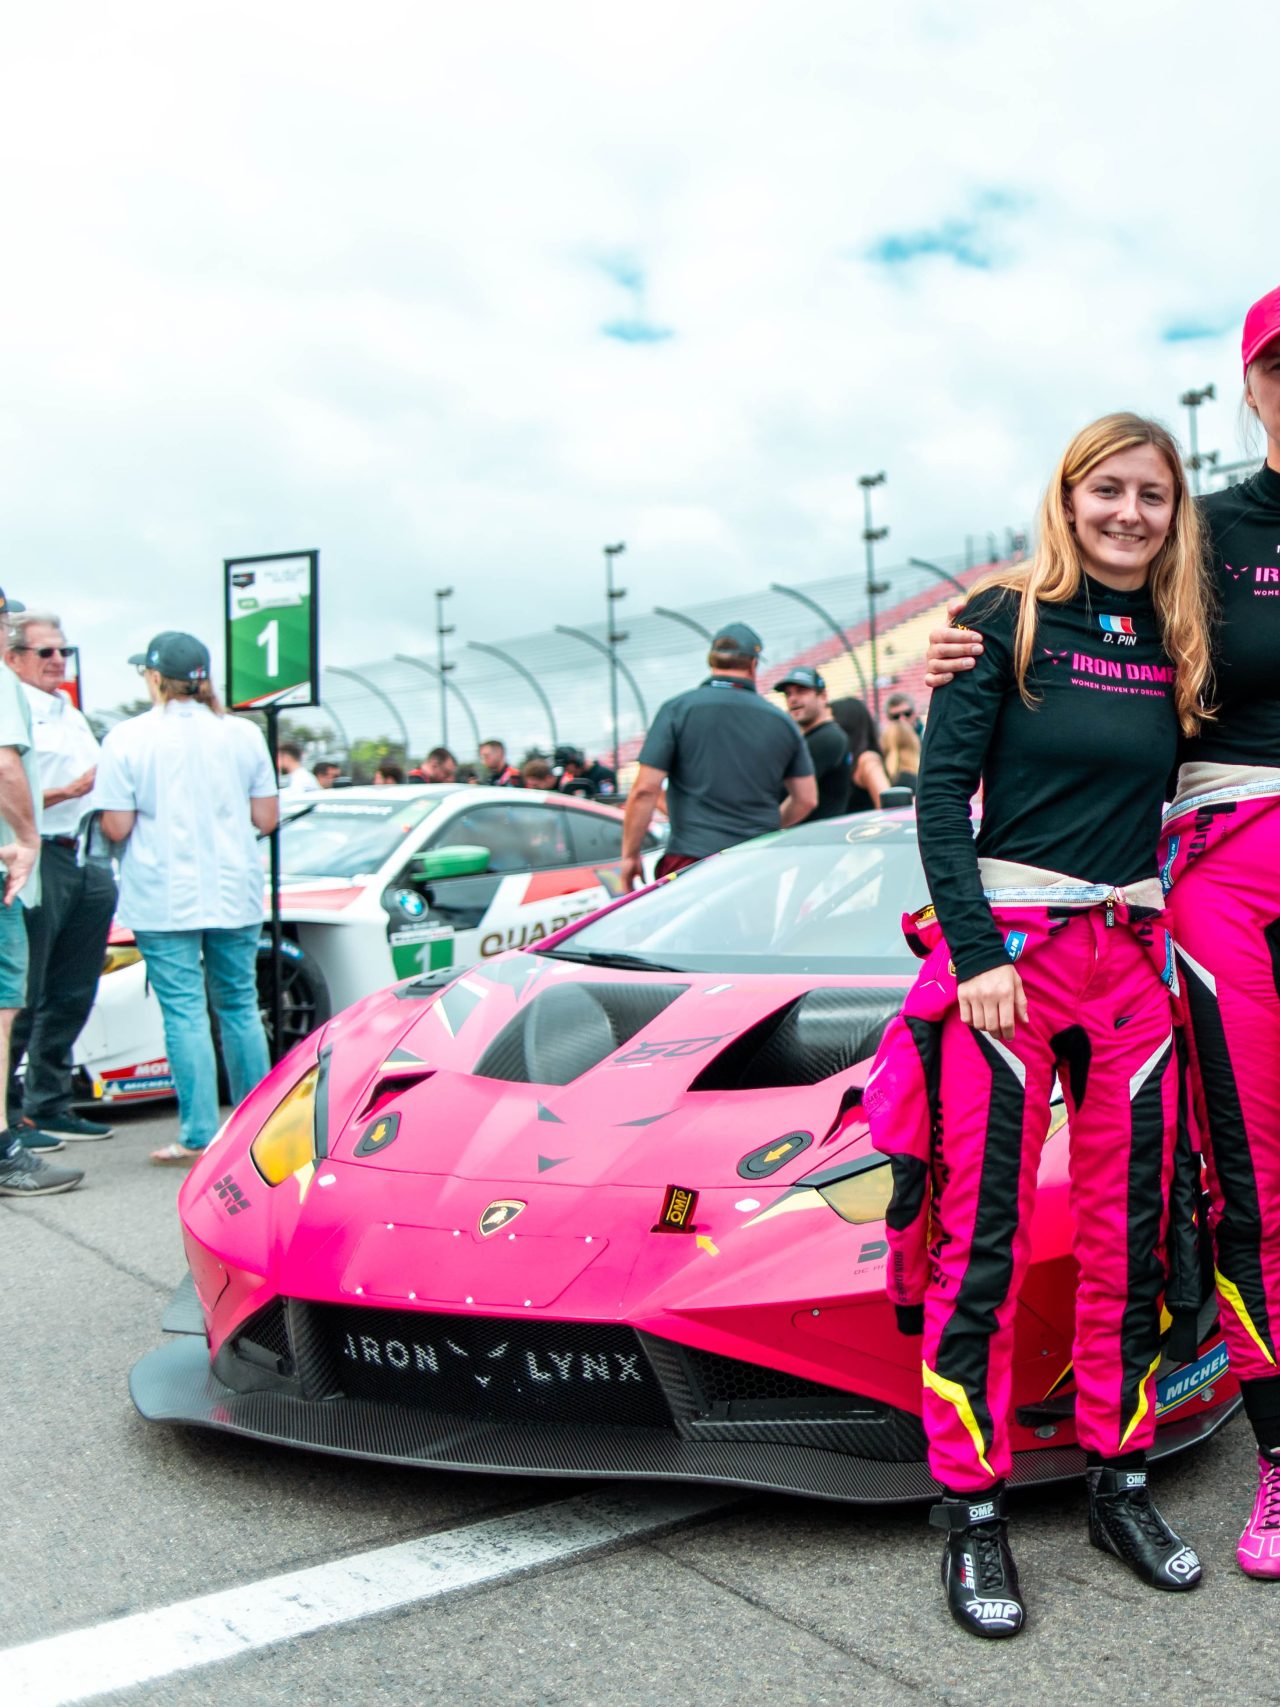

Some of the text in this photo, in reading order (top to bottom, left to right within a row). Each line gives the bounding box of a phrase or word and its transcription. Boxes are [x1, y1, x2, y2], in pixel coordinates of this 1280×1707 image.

[257, 620, 279, 677] 1
[1103, 633, 1137, 646] D. PIN
[1071, 652, 1176, 684] IRON DAME
[1071, 677, 1166, 698] WOMEN DRIVEN BY DREAMS
[415, 943, 432, 973] 1
[670, 1190, 688, 1223] OMP
[345, 1333, 642, 1382] IRON LYNX
[1166, 1353, 1229, 1402] MICHEL
[1126, 1475, 1147, 1486] OMP
[969, 1504, 994, 1519] OMP
[967, 1602, 1019, 1620] OMP
